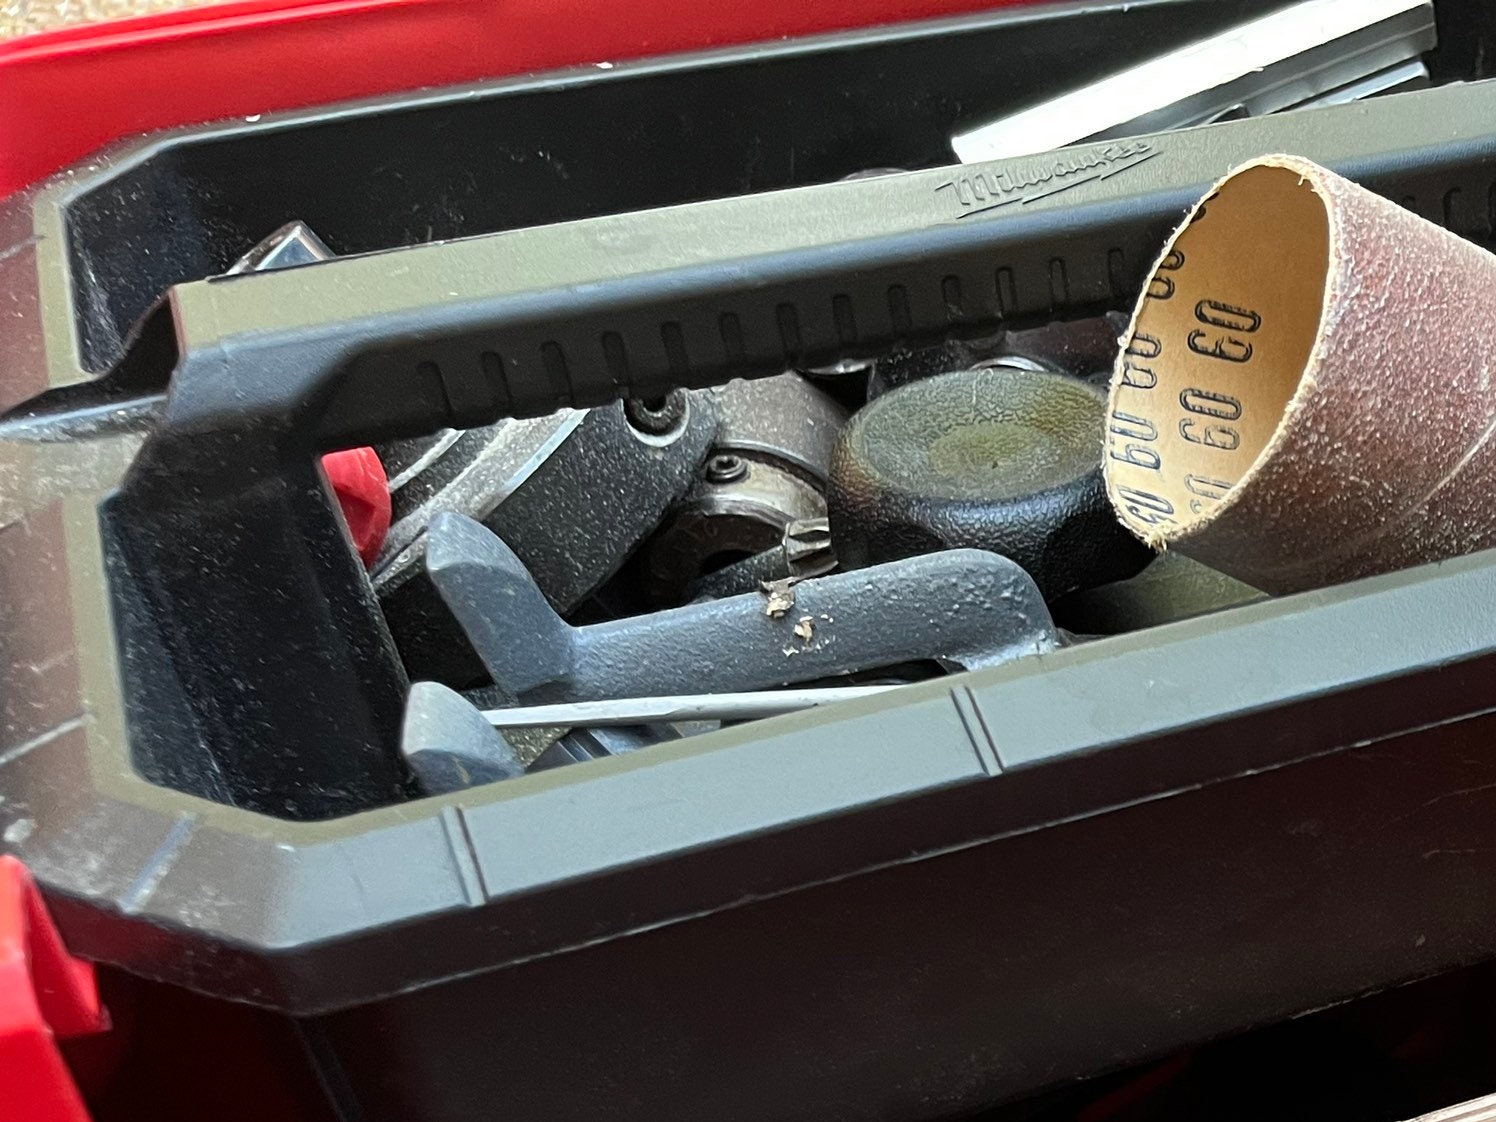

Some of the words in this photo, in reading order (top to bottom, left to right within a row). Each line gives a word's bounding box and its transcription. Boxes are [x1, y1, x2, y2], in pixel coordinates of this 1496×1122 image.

[935, 140, 1153, 207] Milwaukee
[1188, 299, 1262, 363] 60
[1179, 387, 1243, 451] 60
